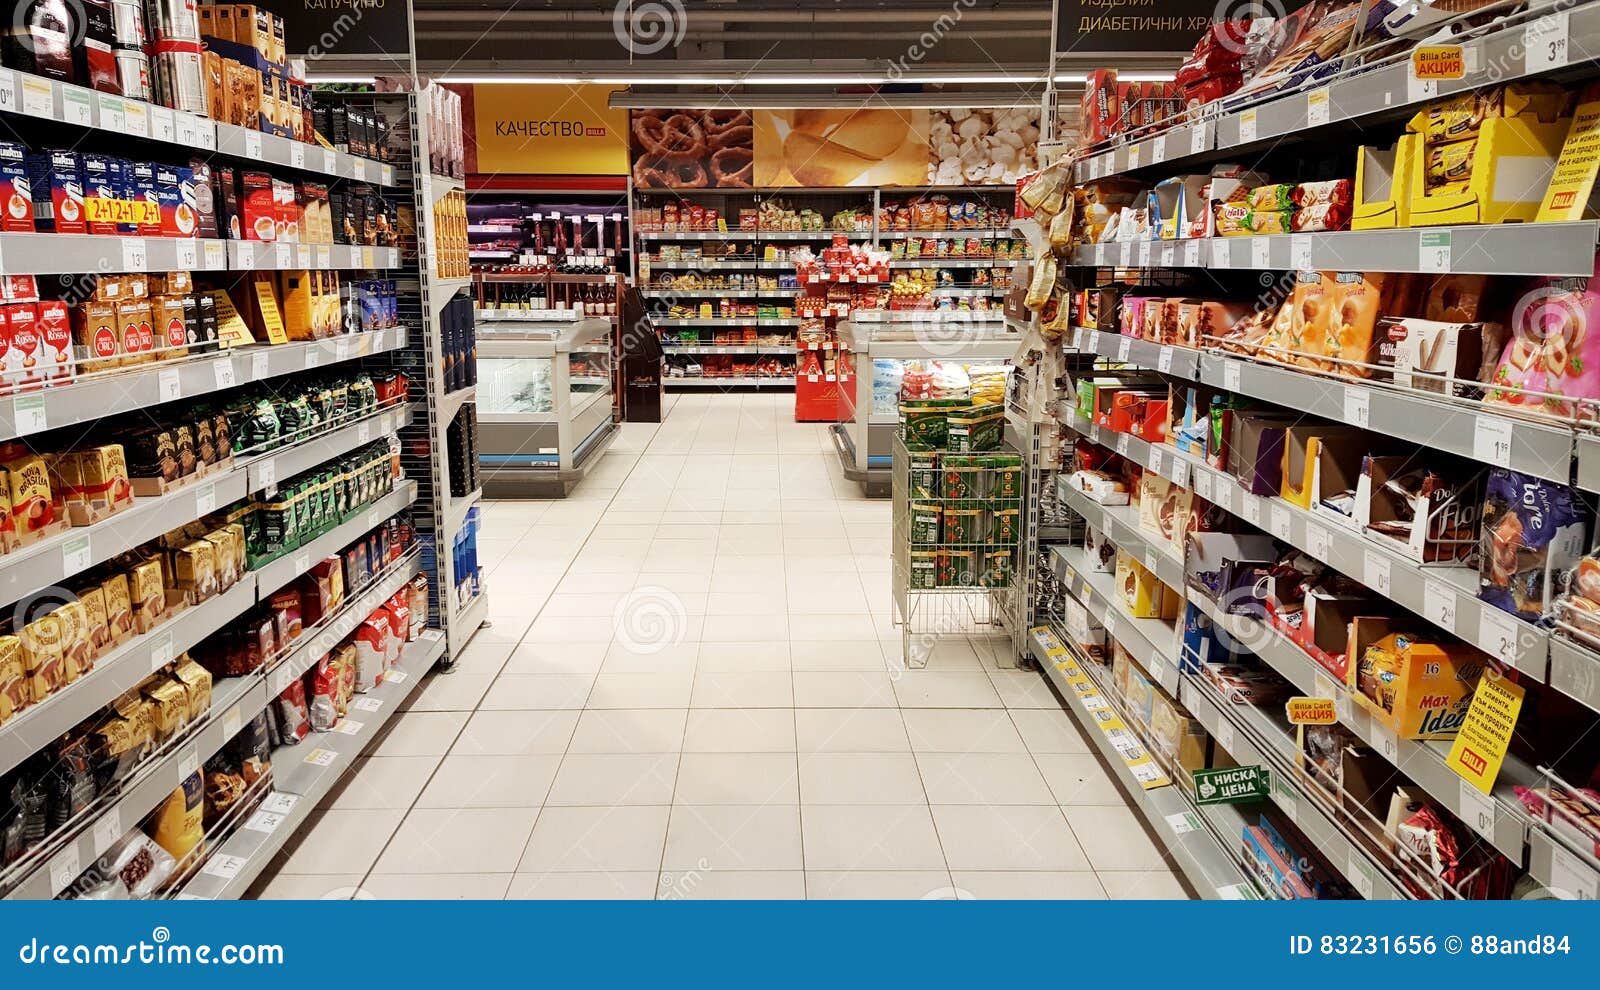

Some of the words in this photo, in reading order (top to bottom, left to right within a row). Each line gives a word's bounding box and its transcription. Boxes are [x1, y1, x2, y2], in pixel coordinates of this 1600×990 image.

[1078, 16, 1183, 33] ДИАБЕТИЧНИ
[1420, 51, 1438, 61] Billa
[1440, 49, 1460, 60] Card
[1418, 61, 1461, 76] АКЦИЯ
[495, 120, 584, 137] КАЧЕСТВО
[93, 199, 113, 219] 2+1
[116, 201, 134, 219] 2+1
[21, 466, 41, 480] NOVA
[1425, 663, 1440, 674] 16
[1313, 701, 1332, 710] Card
[1419, 695, 1450, 709] Max
[1293, 710, 1333, 722] АКЦИЯ
[1461, 750, 1486, 774] BILLA
[1214, 770, 1257, 786] НИСКА
[1221, 783, 1256, 798] ЦЕНА
